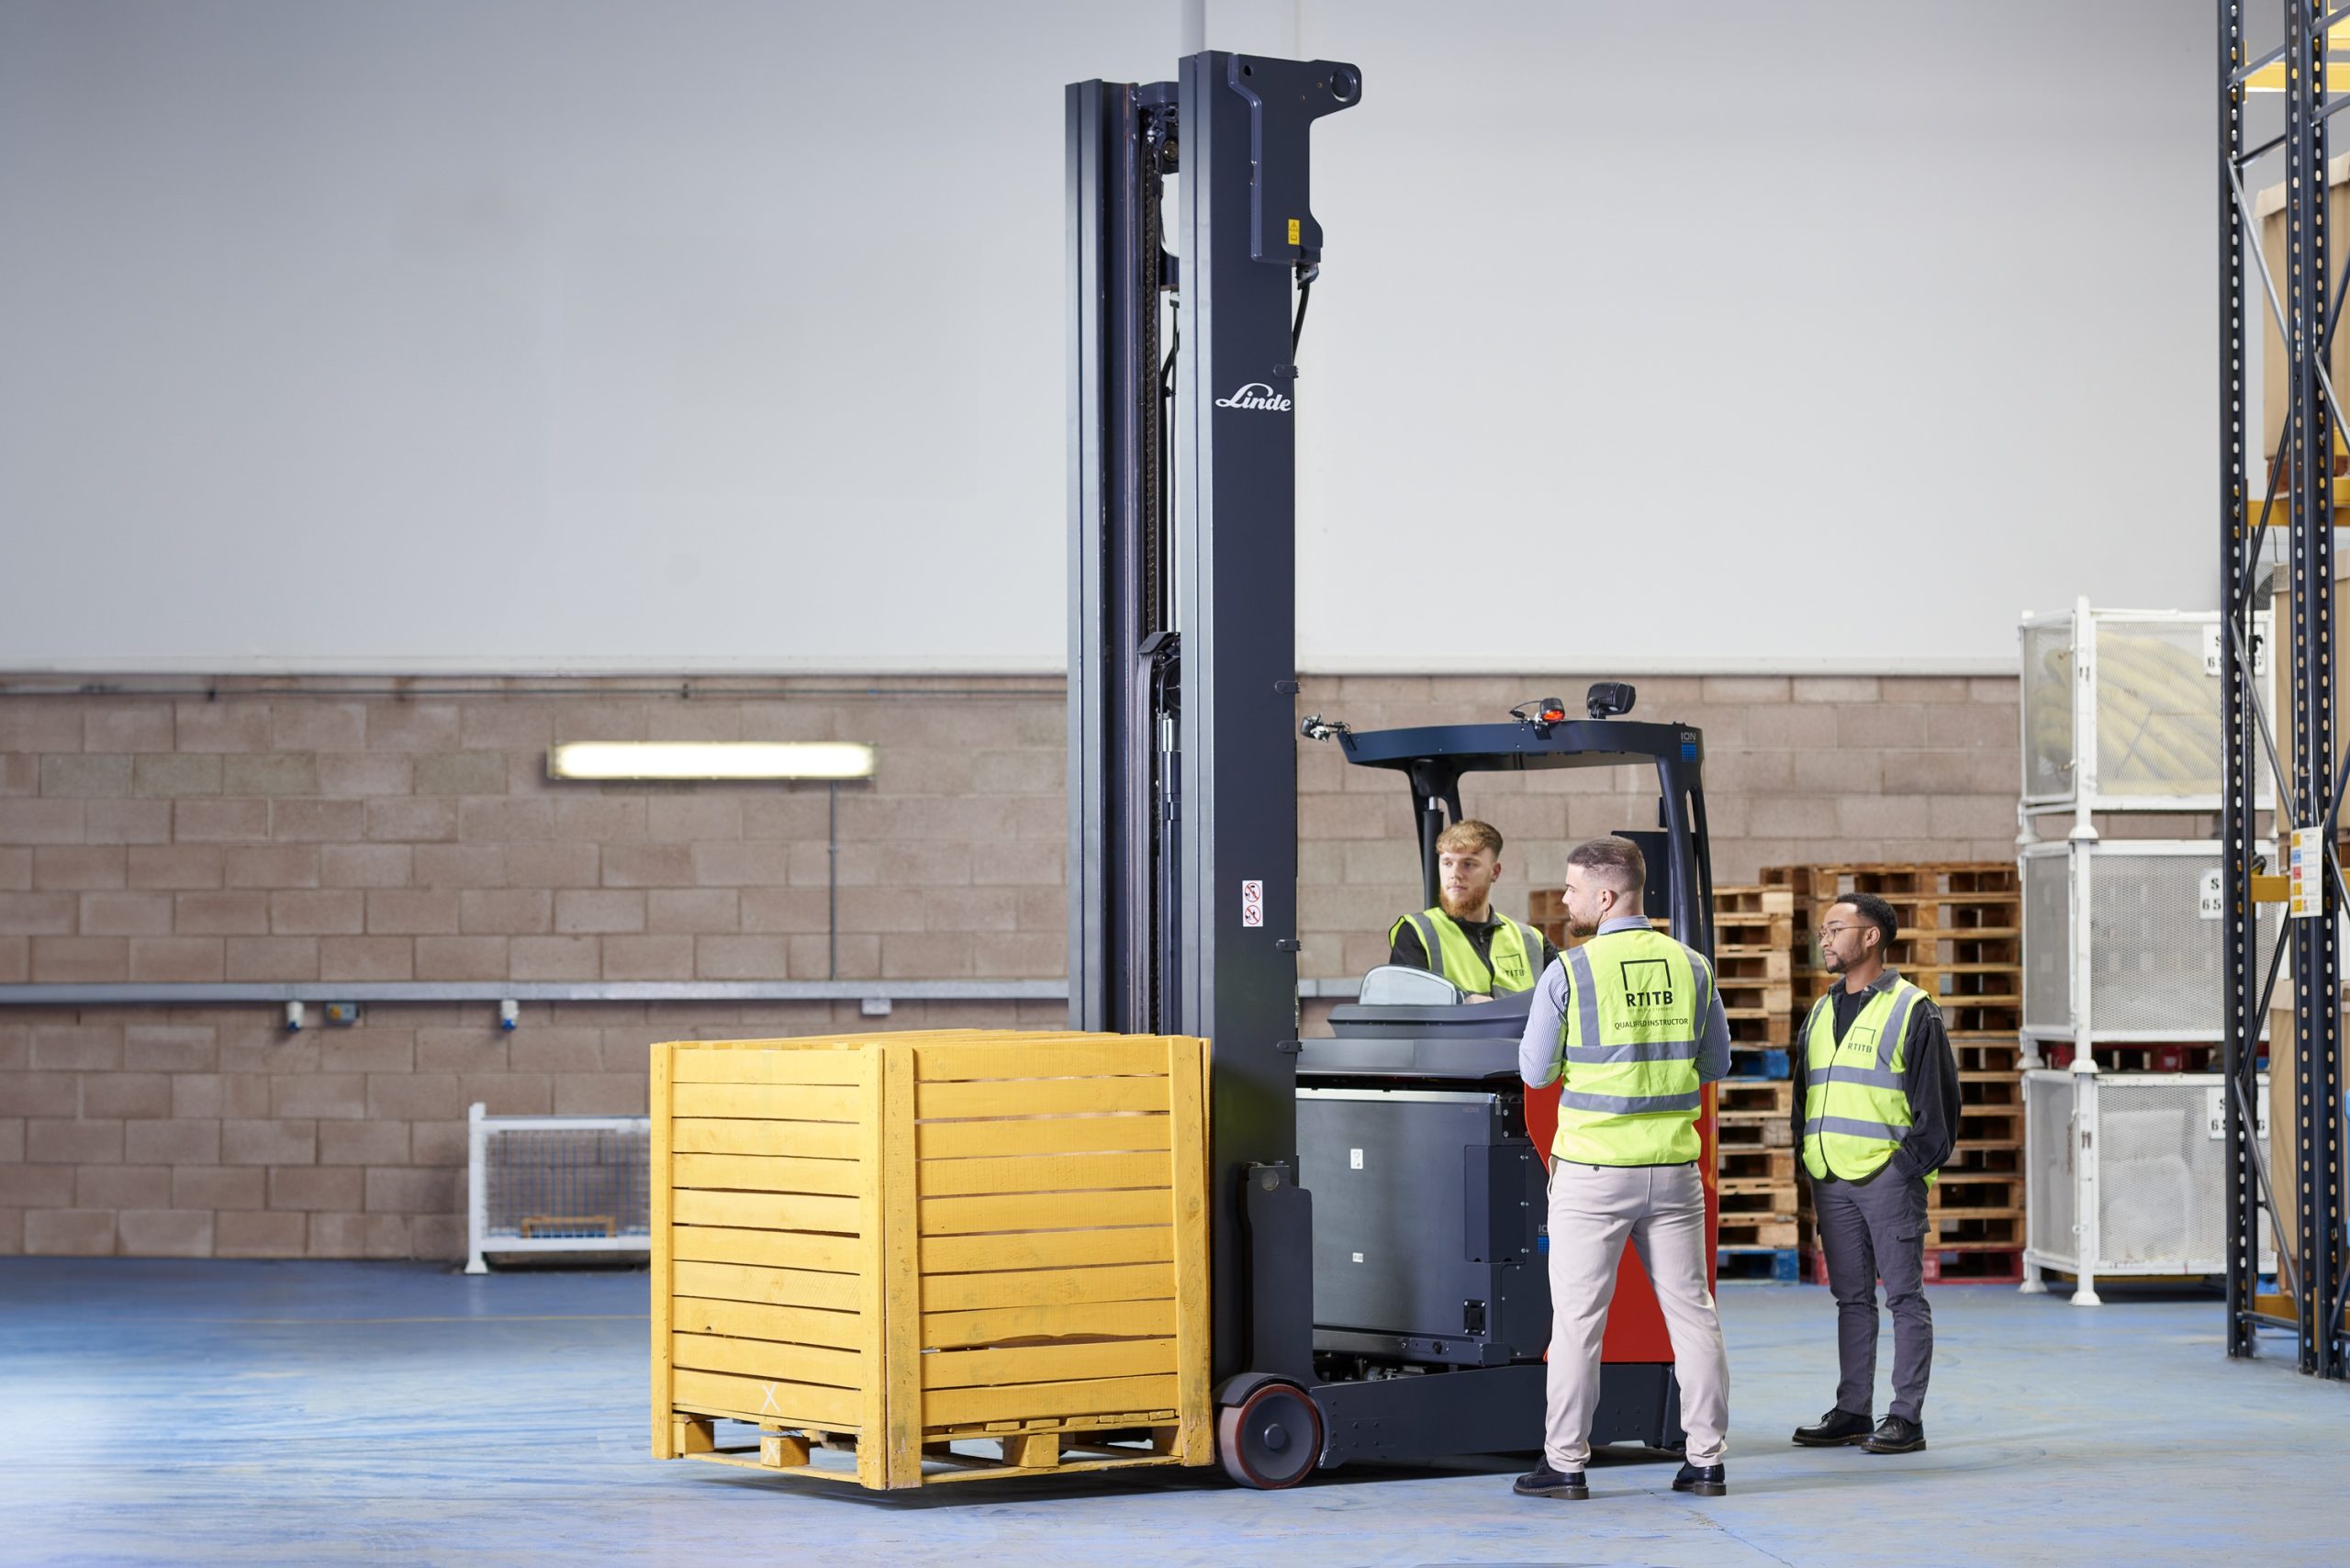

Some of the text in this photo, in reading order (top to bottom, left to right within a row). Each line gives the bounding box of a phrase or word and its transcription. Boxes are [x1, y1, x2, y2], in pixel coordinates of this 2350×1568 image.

[1215, 383, 1292, 411] Linde
[1681, 732, 1696, 741] ION
[1626, 991, 1673, 1007] RTITB
[1615, 1018, 1689, 1030] QUALIFIED INSTRUCTOR
[1847, 1042, 1873, 1053] RTITB
[1538, 1224, 1549, 1233] IO
